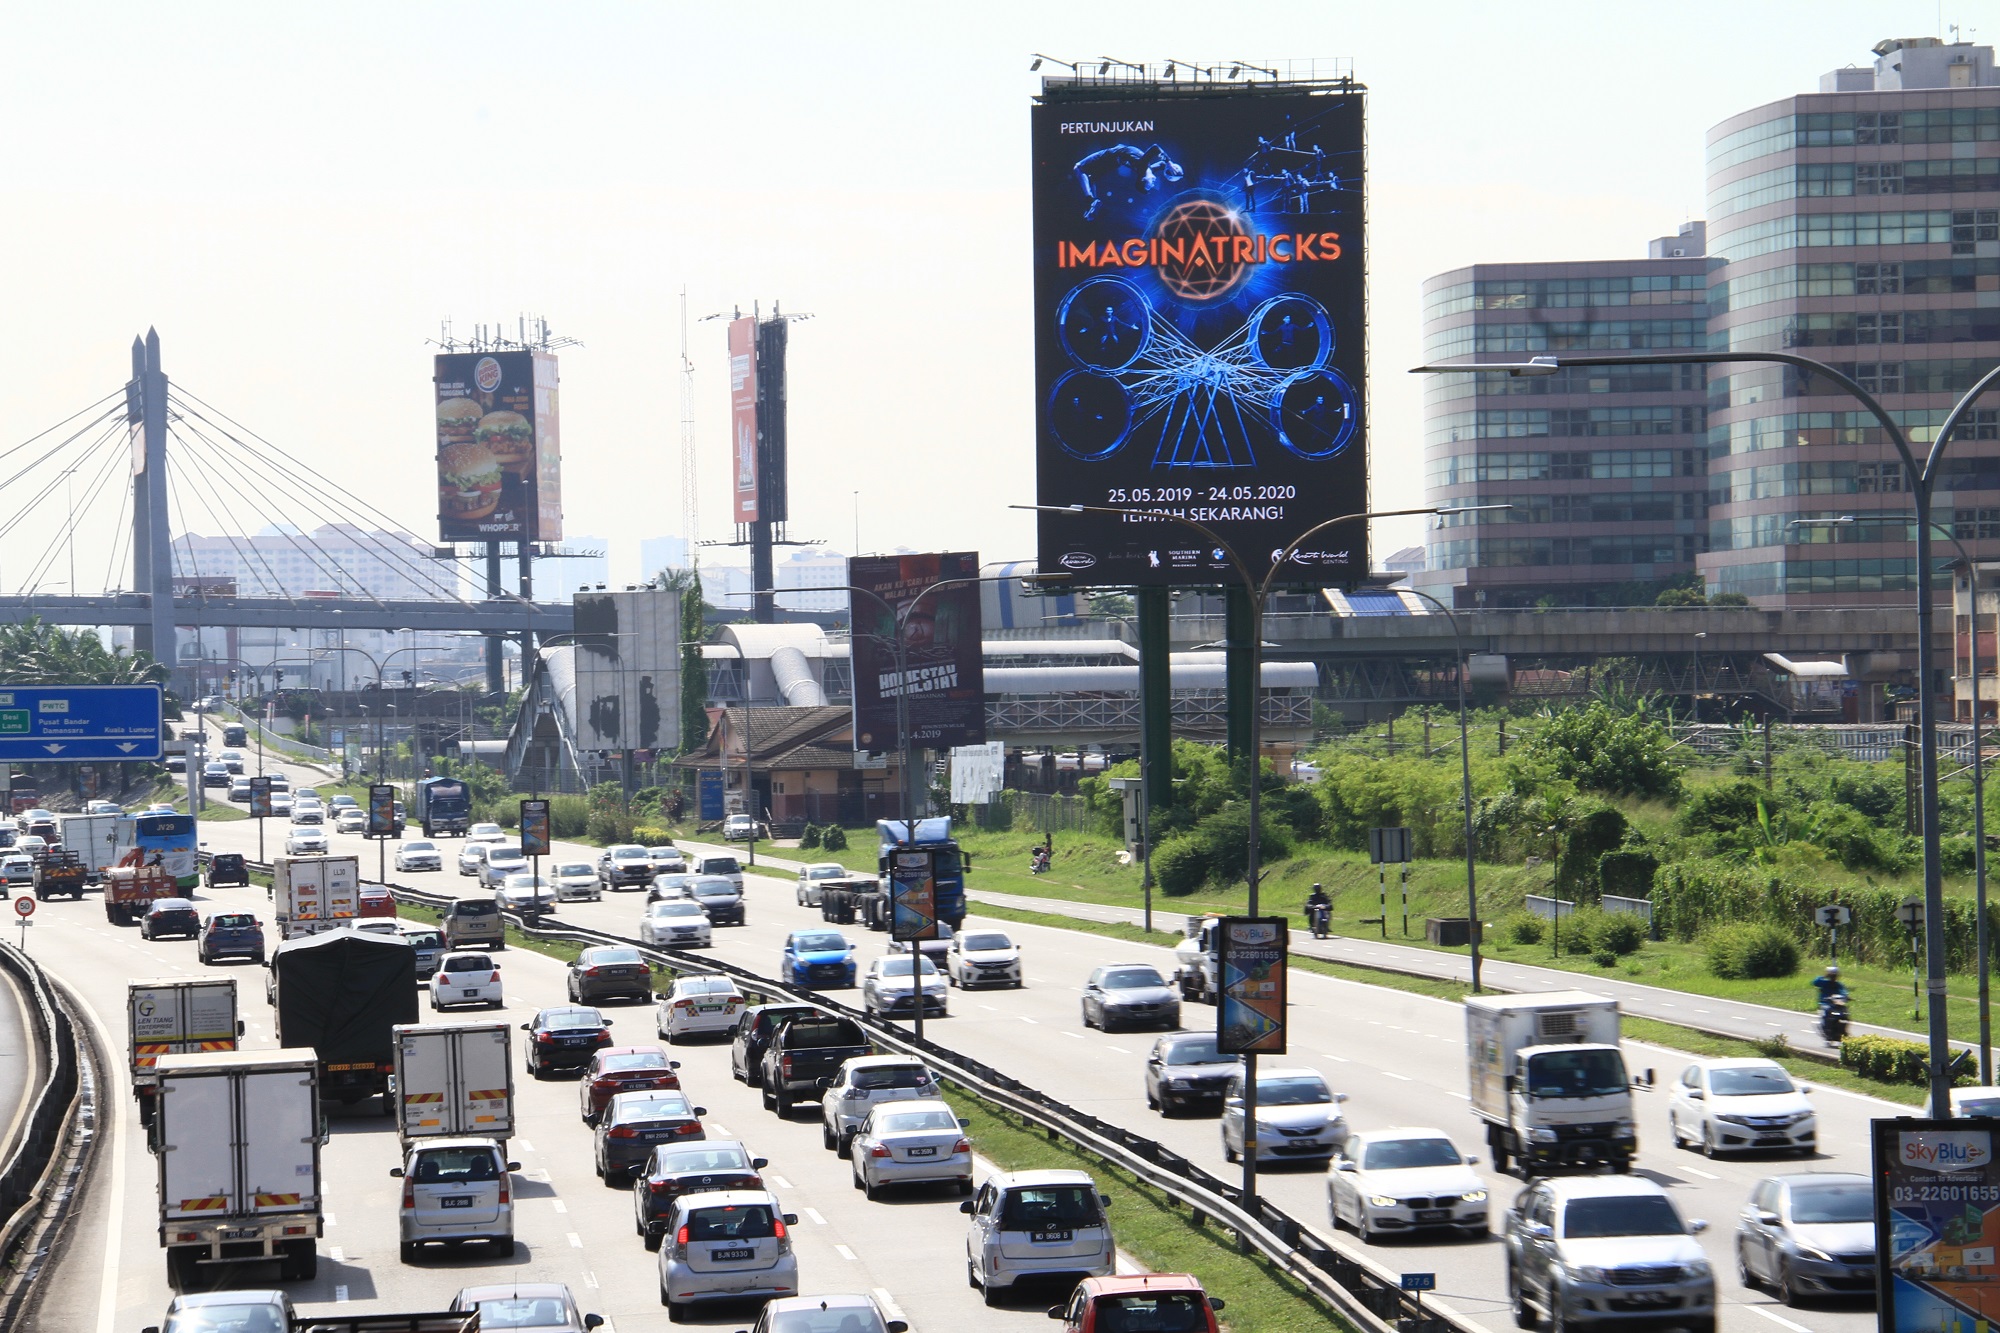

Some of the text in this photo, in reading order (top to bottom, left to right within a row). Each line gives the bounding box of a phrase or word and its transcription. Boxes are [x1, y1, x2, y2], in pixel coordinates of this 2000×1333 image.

[1060, 120, 1154, 134] PERTUNJUKAN
[1057, 230, 1342, 276] IMAGINATRICKS
[1108, 487, 1192, 502] 25.05.2019
[1209, 485, 1296, 501] 24.05.2020
[1190, 506, 1284, 521] SEKARANG!
[38, 718, 90, 726] Pusat Bandar
[42, 727, 84, 735] Damansara
[104, 726, 156, 735] Kuala Lumpur
[20, 902, 31, 910] 50
[1227, 951, 1279, 959] 03-22601655
[1905, 1142, 1981, 1163] SkyBlue
[1910, 1175, 1937, 1183] Contact
[1894, 1185, 1999, 1201] 03-22601655
[731, 1250, 748, 1258] 9330
[1407, 1277, 1430, 1287] 27.6
